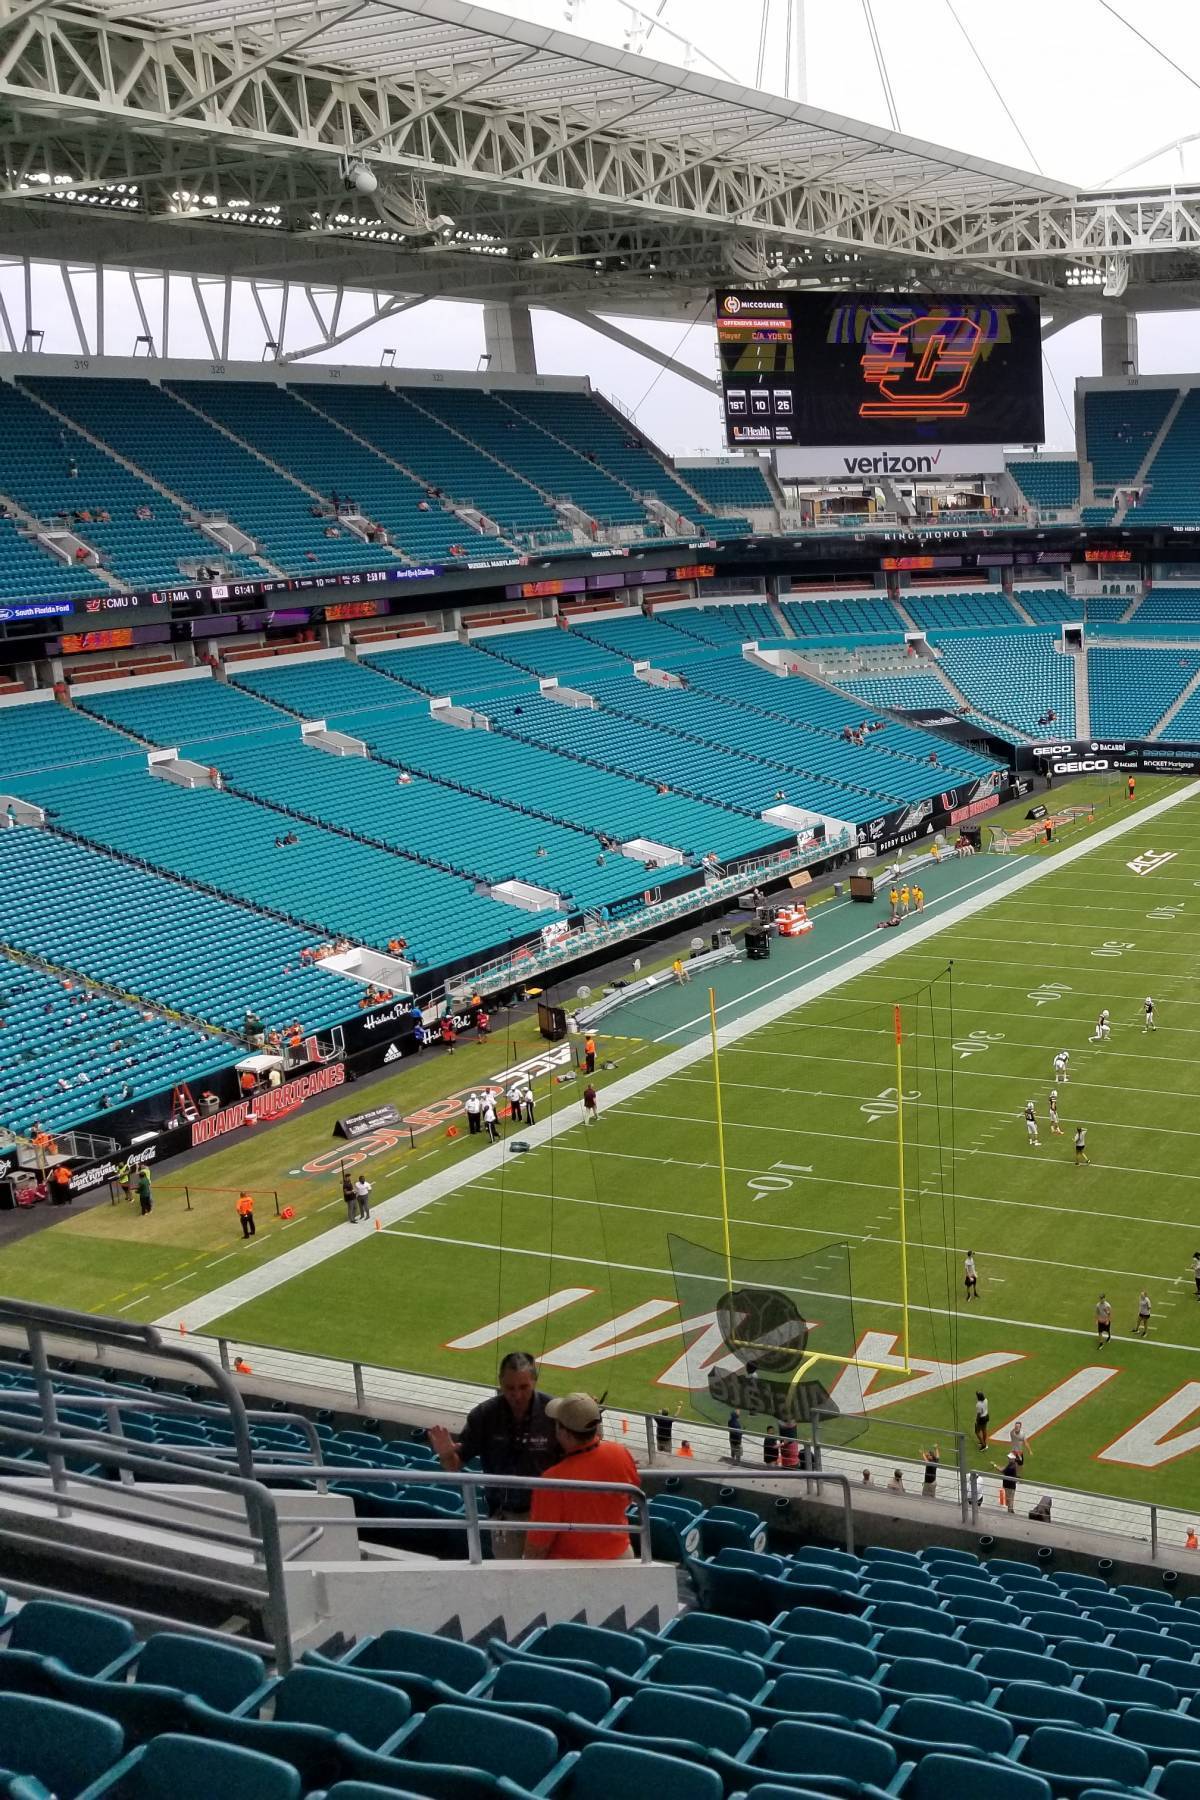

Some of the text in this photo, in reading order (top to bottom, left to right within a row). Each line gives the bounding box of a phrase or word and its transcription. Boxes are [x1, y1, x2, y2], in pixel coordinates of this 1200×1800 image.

[741, 301, 784, 309] MICCOSUKEE
[729, 401, 745, 410] 1ST
[755, 401, 766, 411] 10
[777, 401, 790, 410] 25
[844, 451, 932, 474] verizon
[884, 531, 968, 541] RING HONOR
[294, 580, 299, 588] 1
[315, 578, 324, 587] 10
[352, 575, 360, 583] 25
[173, 590, 202, 601] MIA 0
[234, 585, 255, 595] 61:41
[106, 596, 138, 609] CMU 0
[15, 609, 34, 617] South
[34, 606, 55, 615] Florida
[55, 604, 70, 613] Ford
[1033, 745, 1071, 756] GEICO
[1053, 760, 1109, 773] GEICO
[900, 830, 917, 843] ELLIS
[1125, 850, 1173, 875] ACC
[1090, 941, 1136, 957] 50
[1026, 982, 1072, 1001] 40
[394, 1002, 412, 1018] Park
[452, 1014, 471, 1029] Park
[951, 1029, 1006, 1052] 30
[192, 1062, 345, 1147] MIAMI HURRICANES
[859, 1086, 922, 1115] 20
[746, 1159, 814, 1192] 10
